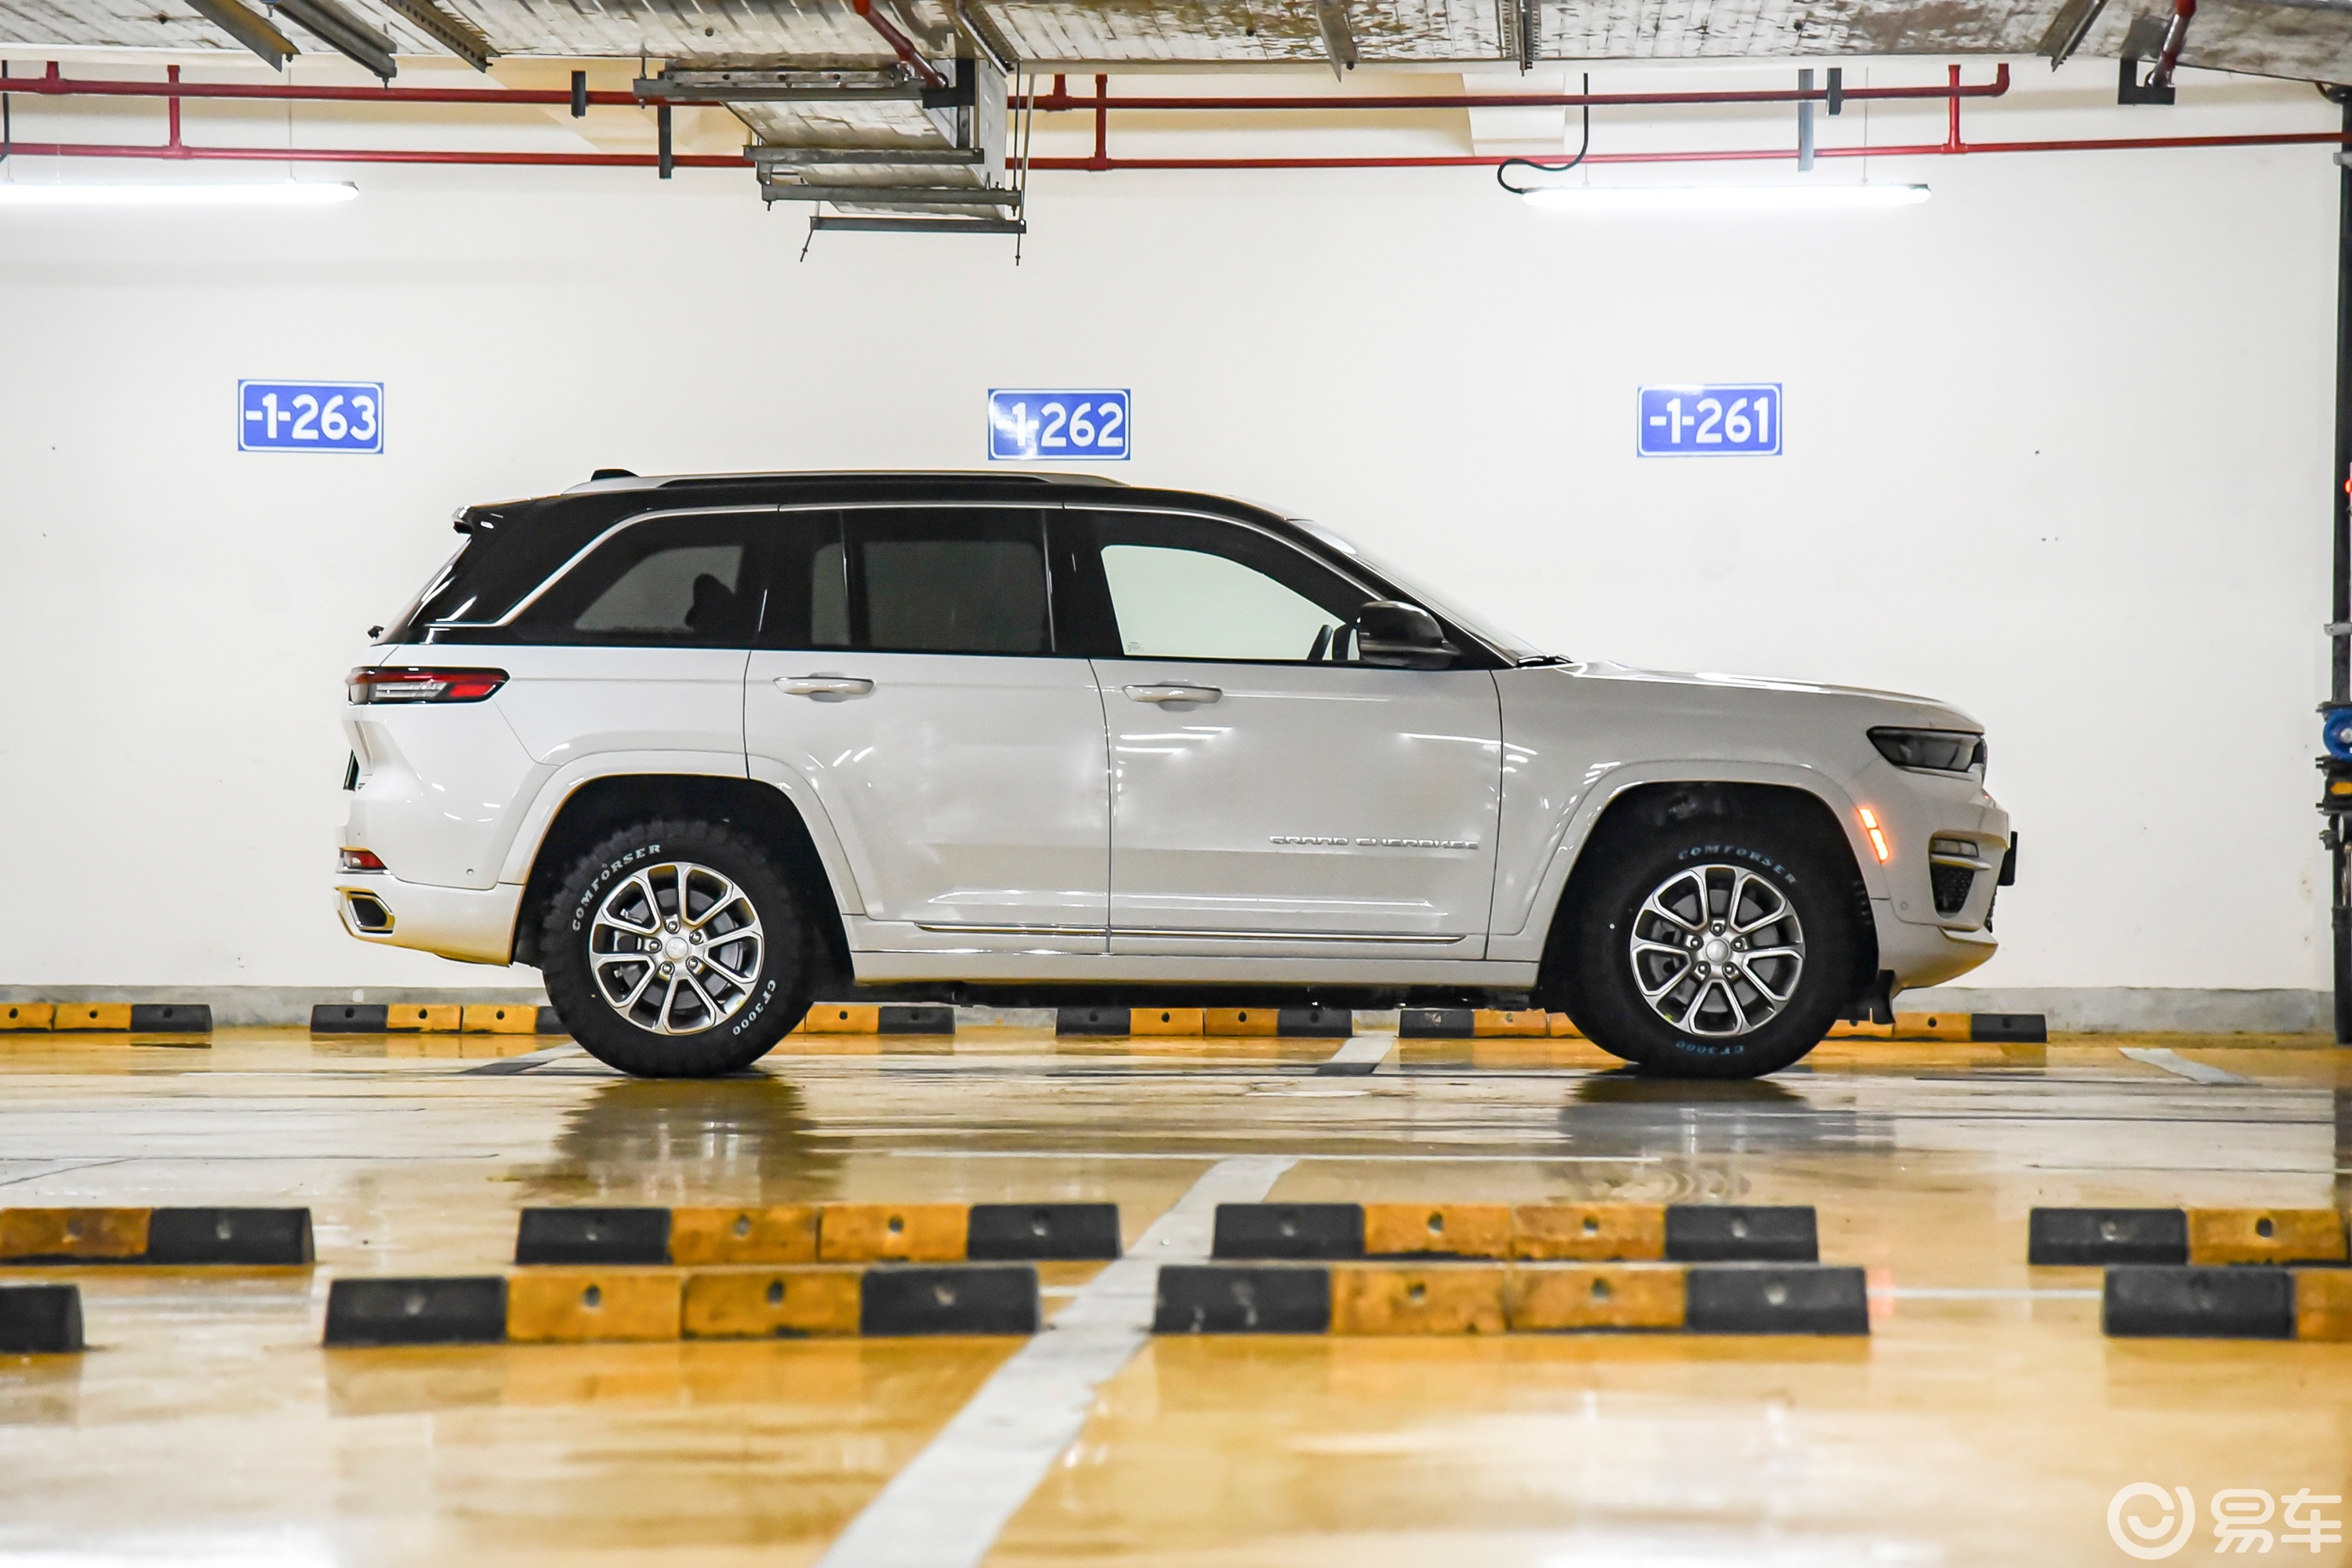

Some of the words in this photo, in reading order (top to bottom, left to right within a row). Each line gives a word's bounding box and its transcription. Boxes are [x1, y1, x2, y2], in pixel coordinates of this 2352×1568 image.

[245, 392, 376, 441] -1-263
[1650, 397, 1769, 444] -1-261
[572, 844, 661, 931] COMFORSER
[1677, 844, 1797, 884] COMFORSER
